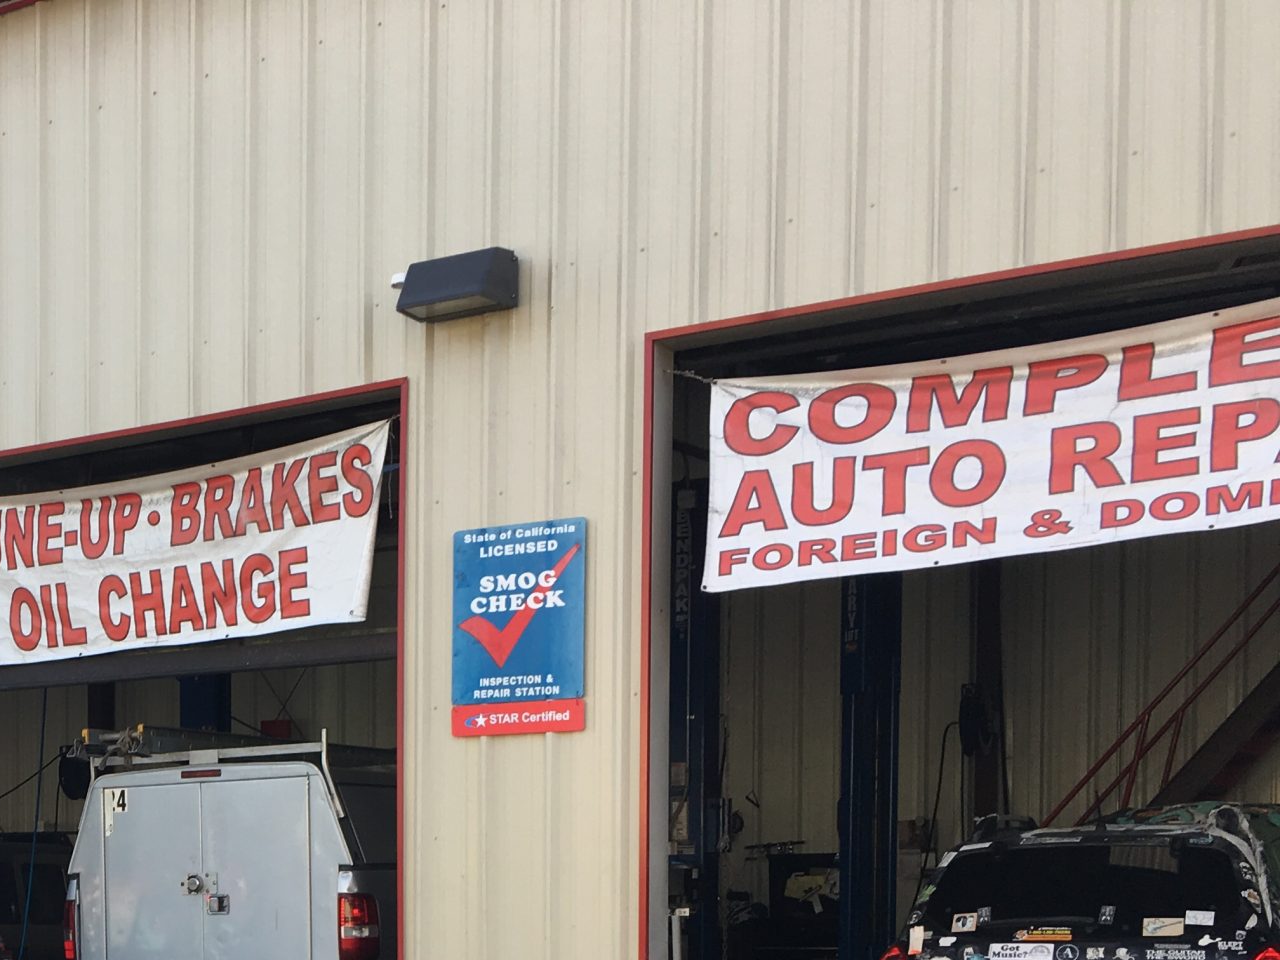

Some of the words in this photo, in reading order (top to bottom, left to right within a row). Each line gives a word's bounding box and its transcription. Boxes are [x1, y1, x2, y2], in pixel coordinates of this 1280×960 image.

[719, 438, 1007, 538] AUTO
[1048, 398, 1280, 495] REP
[170, 443, 373, 547] BRAKES
[464, 531, 495, 544] State
[500, 529, 512, 540] of
[515, 523, 576, 539] California
[719, 517, 997, 576] FOREIGN
[1023, 508, 1073, 539] &
[1100, 477, 1280, 529] DOM
[479, 540, 558, 558] LICENSED
[479, 570, 558, 593] SMOG
[9, 579, 88, 651] OIL
[98, 546, 311, 642] CHANGE
[470, 590, 566, 614] CHECK
[479, 675, 542, 687] INSPECTION
[546, 674, 554, 684] &
[473, 687, 511, 699] REPAIR
[515, 686, 560, 698] STATION
[489, 713, 519, 725] STAR
[521, 710, 570, 724] Certified
[992, 951, 1028, 959] Music?
[1001, 944, 1020, 952] Got
